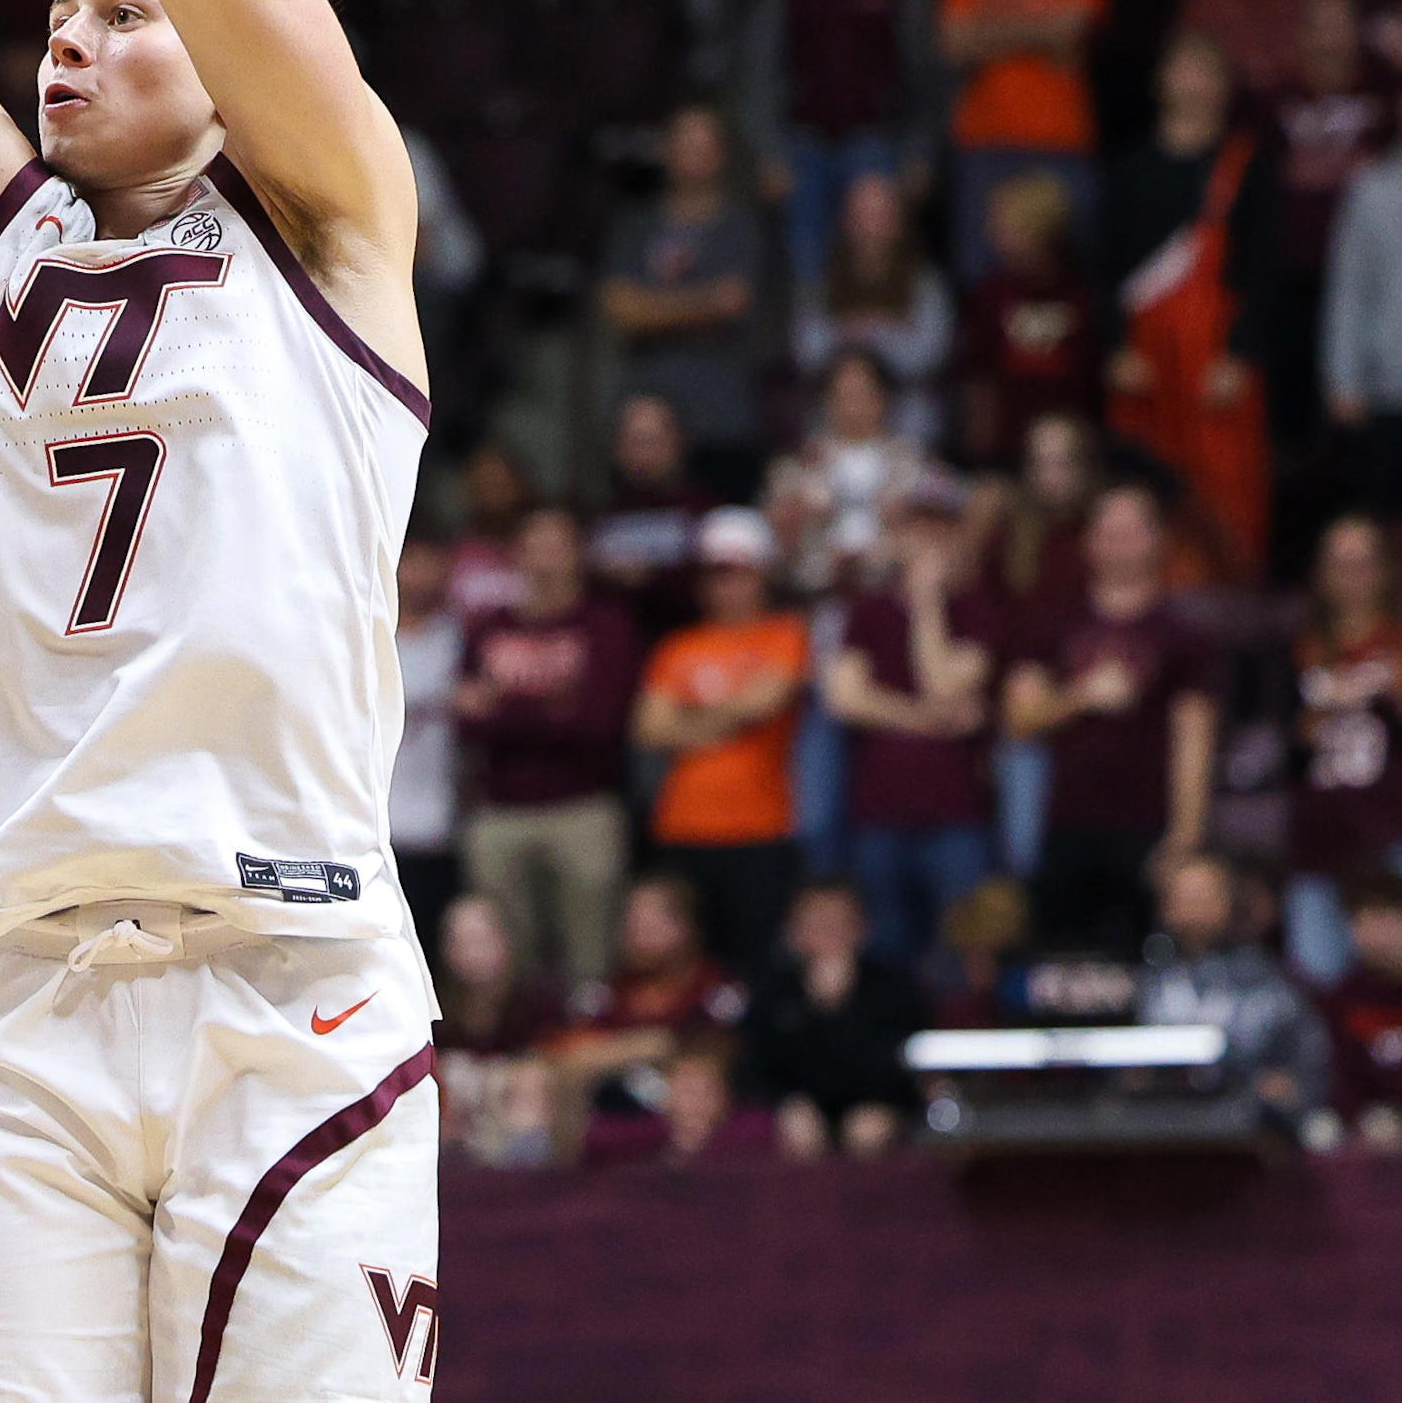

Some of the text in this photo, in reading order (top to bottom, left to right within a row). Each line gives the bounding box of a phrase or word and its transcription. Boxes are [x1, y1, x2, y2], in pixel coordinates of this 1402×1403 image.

[180, 215, 215, 244] ACC
[45, 430, 167, 635] 7
[332, 871, 354, 891] 44
